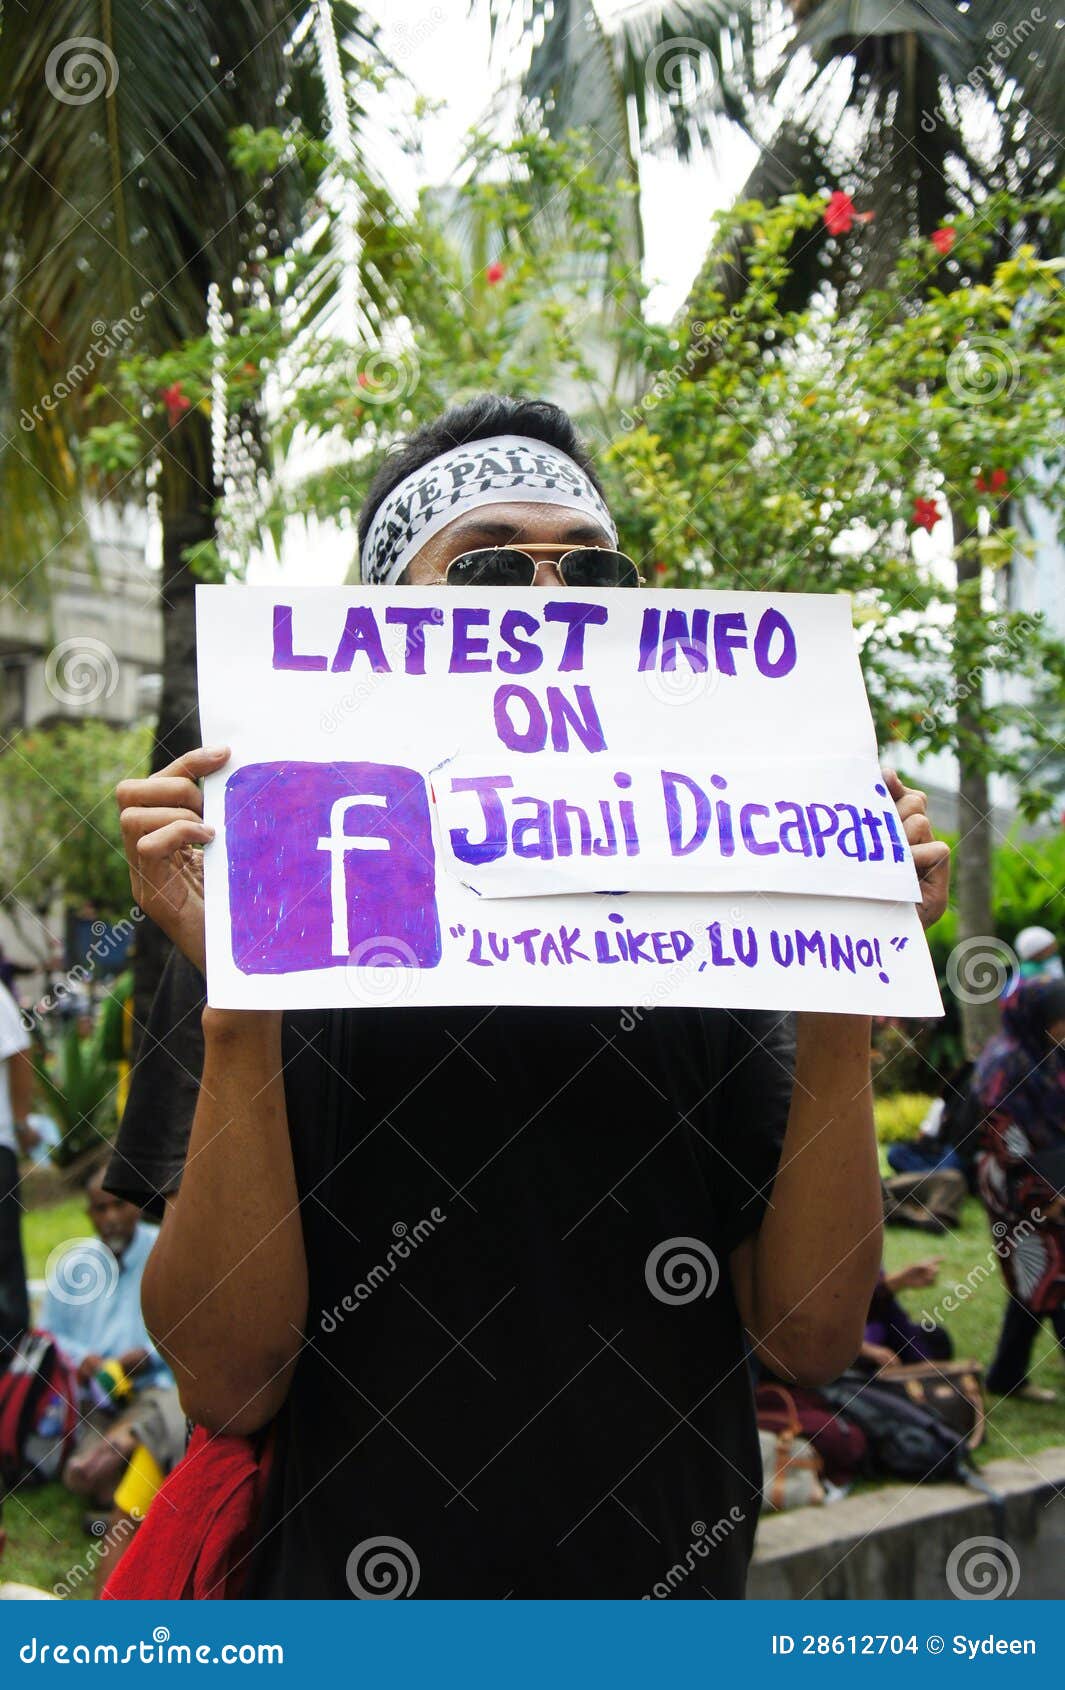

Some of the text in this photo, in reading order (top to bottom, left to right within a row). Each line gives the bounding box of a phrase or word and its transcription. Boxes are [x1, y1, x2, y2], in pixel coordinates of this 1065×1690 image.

[273, 602, 796, 678] LATEST INFO
[494, 684, 606, 752] ON
[449, 772, 640, 865] Janji
